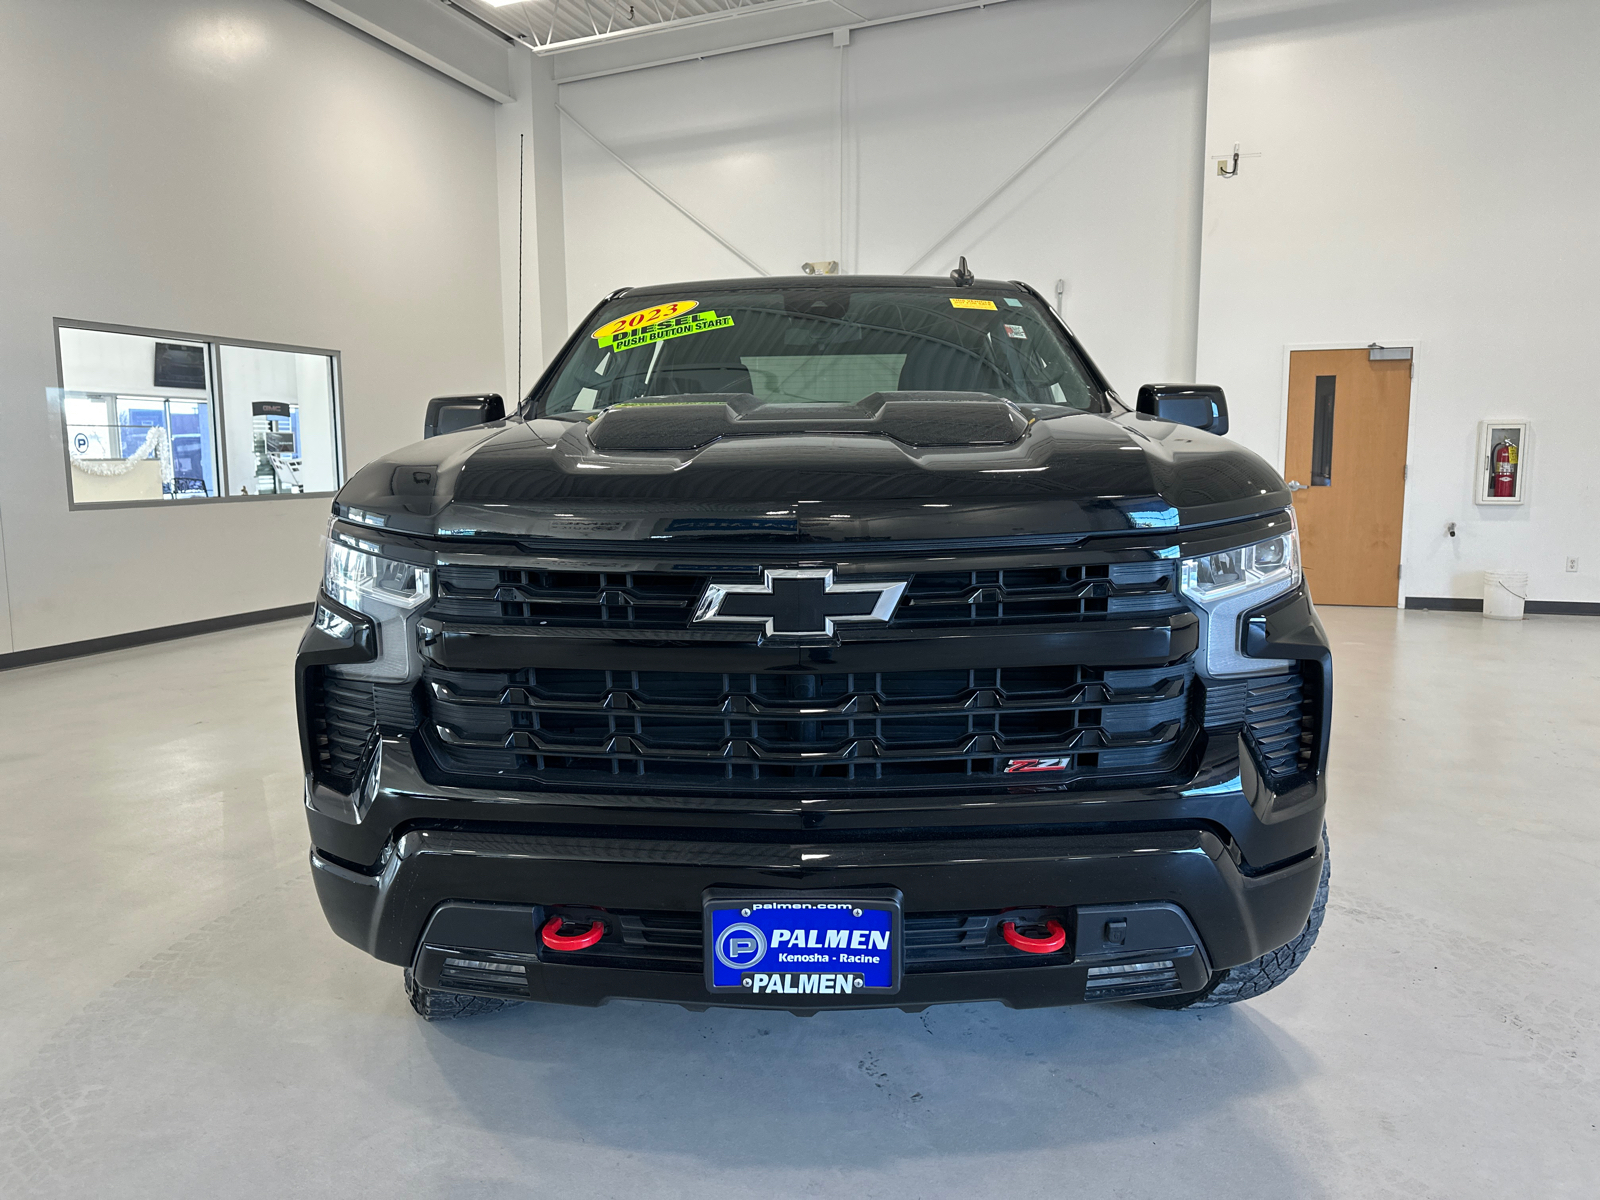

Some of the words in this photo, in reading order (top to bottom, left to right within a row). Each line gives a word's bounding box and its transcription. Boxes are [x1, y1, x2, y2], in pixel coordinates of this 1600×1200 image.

[611, 303, 679, 334] 2023
[612, 314, 707, 342] DIESEL
[616, 335, 648, 350] PUSH
[649, 325, 694, 341] BUTTON
[695, 316, 731, 331] START
[752, 902, 853, 911] palmen.com
[770, 929, 890, 950] PALMEN
[778, 952, 829, 963] Kenosha
[839, 953, 880, 964] Racine
[752, 973, 854, 994] PALMEN
